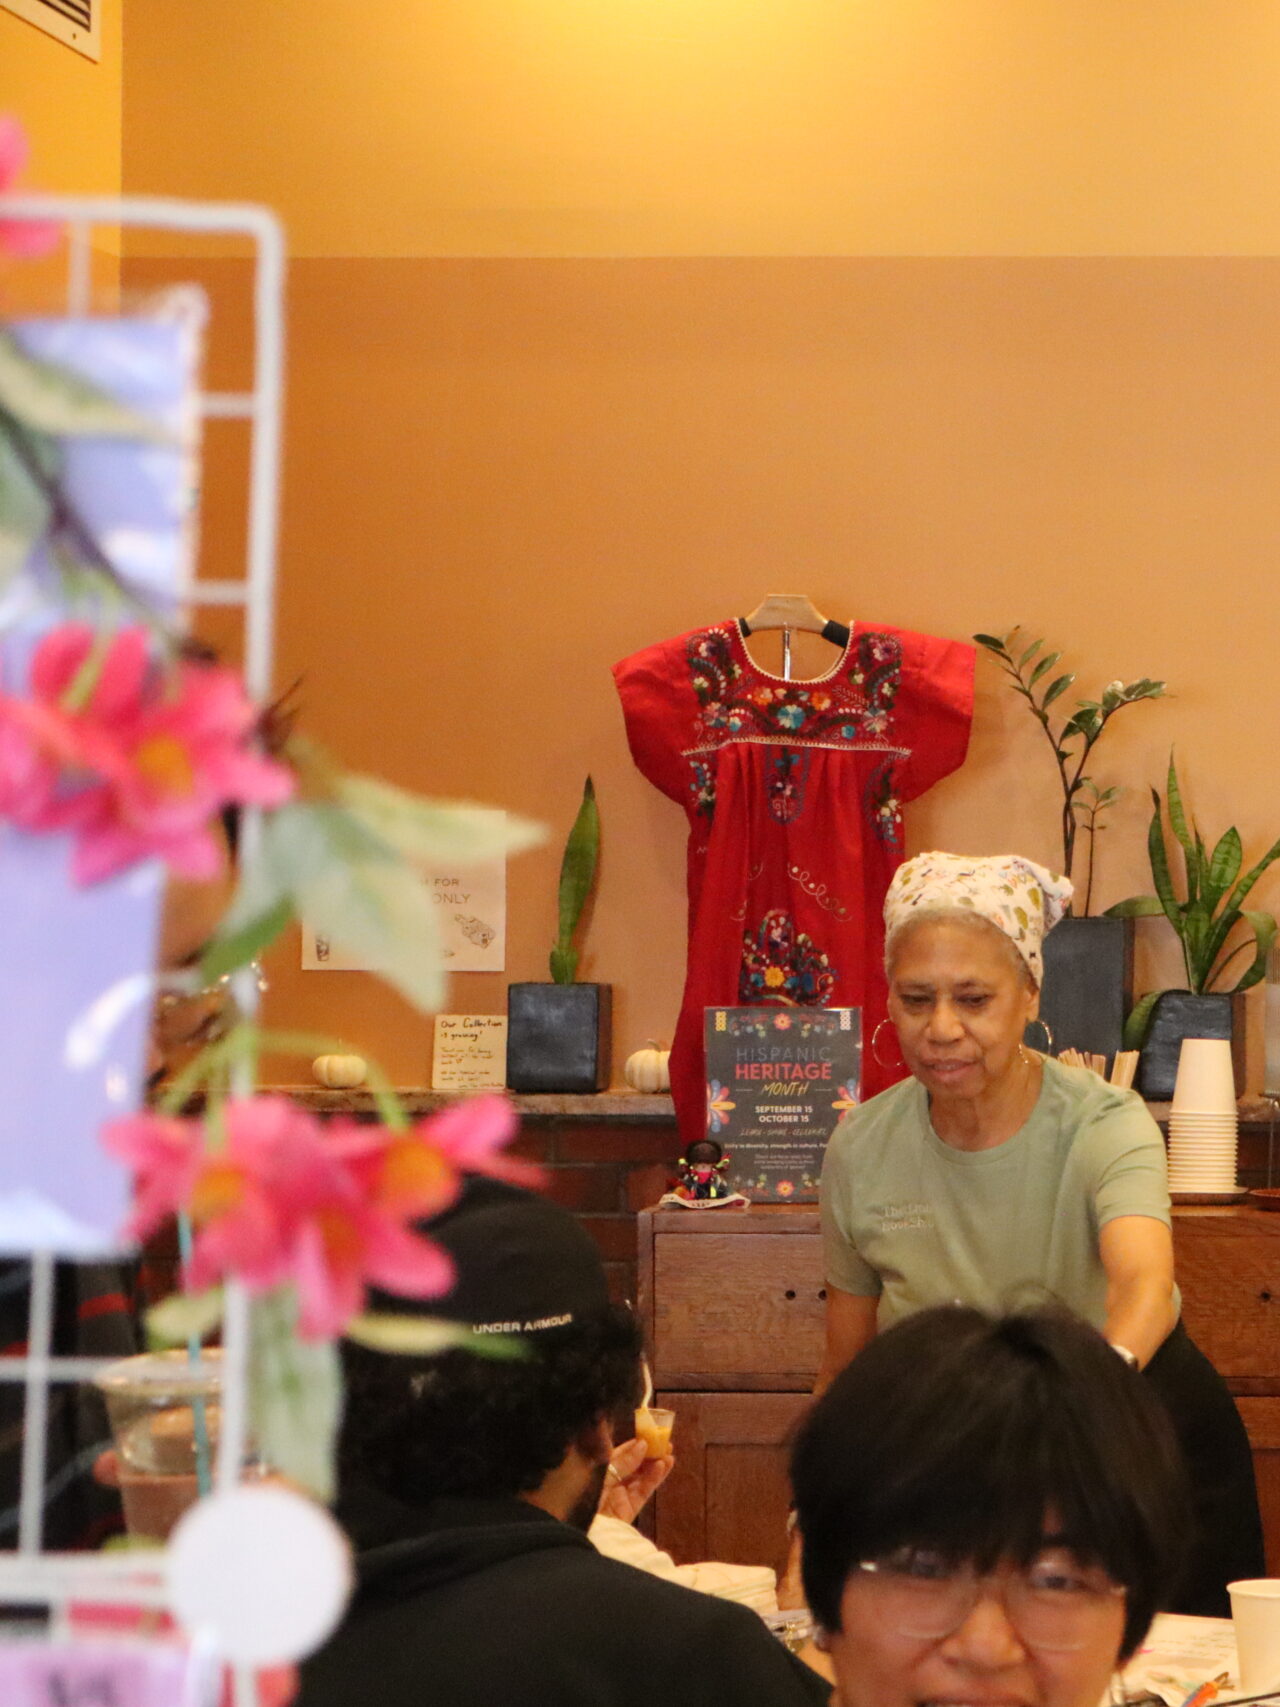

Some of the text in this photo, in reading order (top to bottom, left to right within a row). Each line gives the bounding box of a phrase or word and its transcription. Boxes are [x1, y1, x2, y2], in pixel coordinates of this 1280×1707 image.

[434, 878, 459, 887] FOR
[736, 1047, 831, 1062] HISPANIC
[735, 1063, 832, 1080] HERITAGE
[761, 1081, 810, 1098] MONTH
[755, 1105, 813, 1113] SEPTEMBER 15
[758, 1115, 810, 1123] OCTOBER 15
[473, 1313, 574, 1334] UNDER ARMOUR
